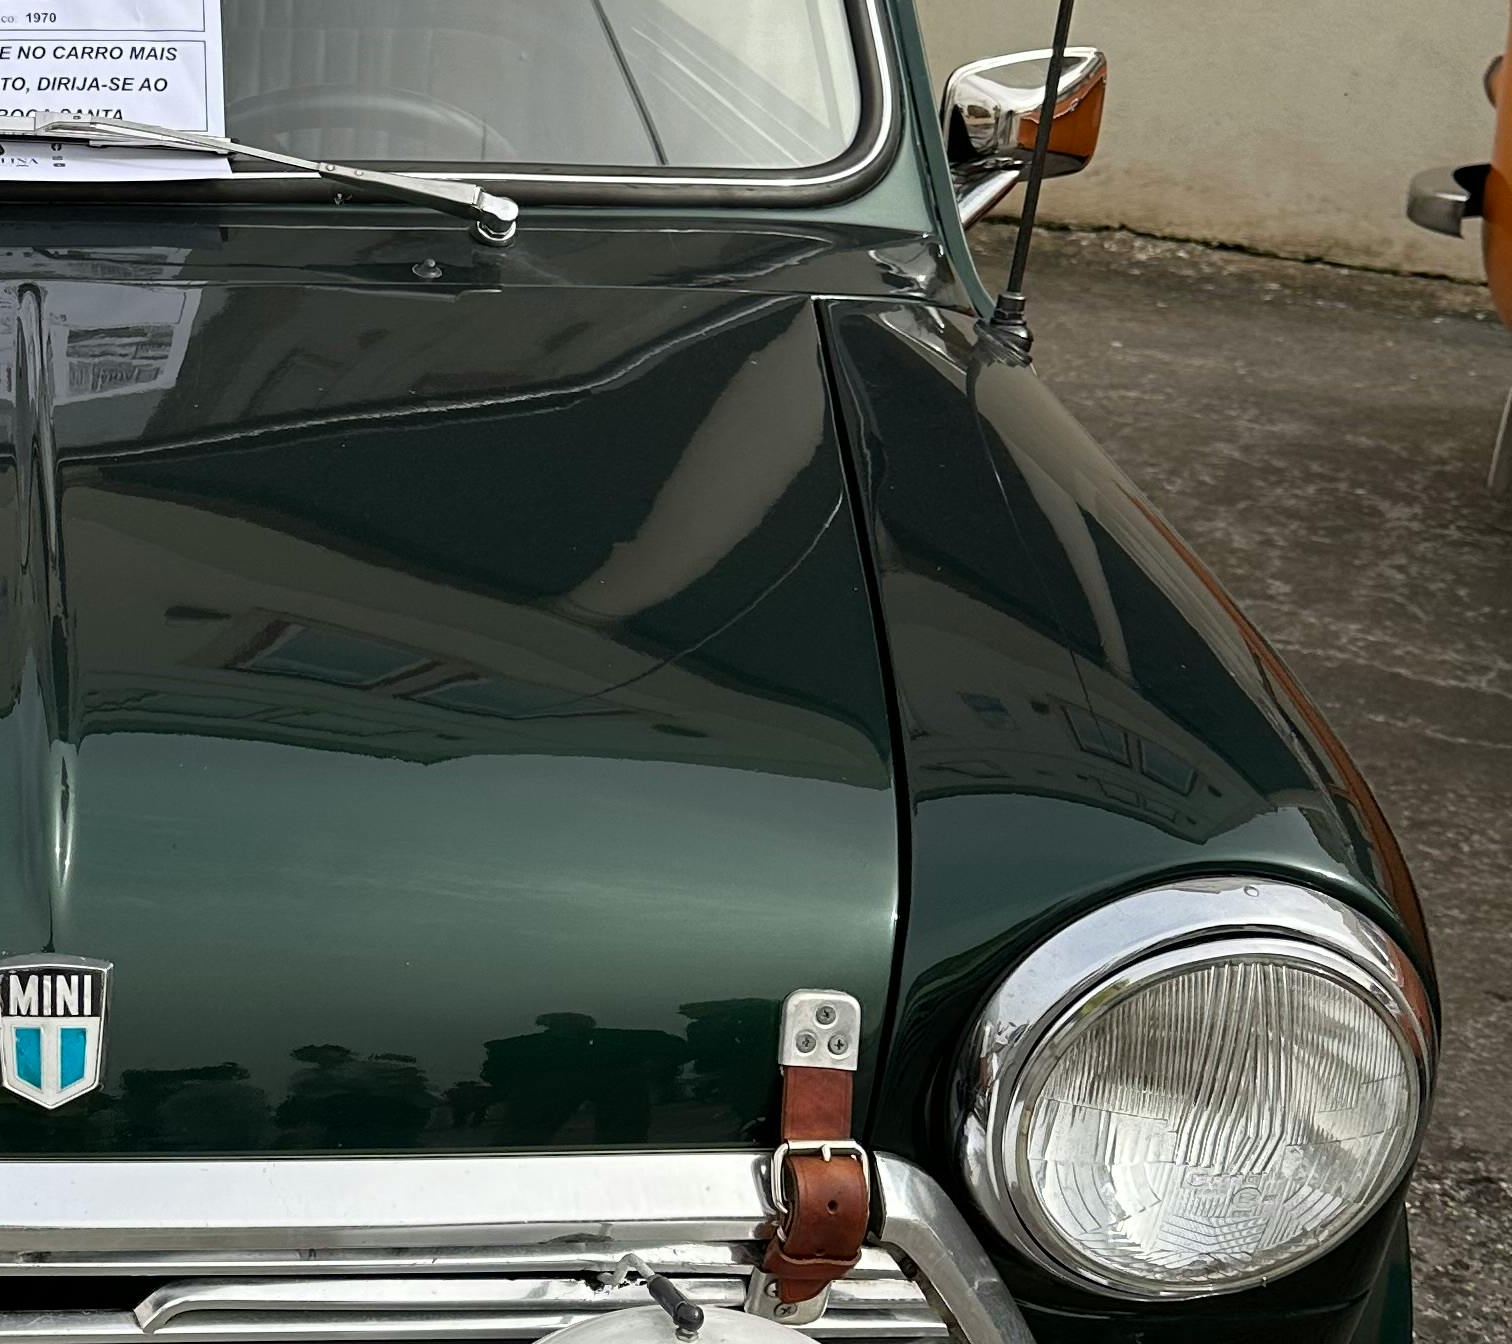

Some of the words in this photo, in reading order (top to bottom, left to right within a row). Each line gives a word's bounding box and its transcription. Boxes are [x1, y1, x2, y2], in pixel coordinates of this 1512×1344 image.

[25, 12, 57, 24] 1970
[17, 45, 47, 60] NO
[53, 45, 124, 60] CARRO
[129, 46, 178, 61] MAIS
[37, 76, 135, 92] DIRIJA-SE
[138, 77, 169, 92] AO
[8, 974, 93, 1017] MINI
